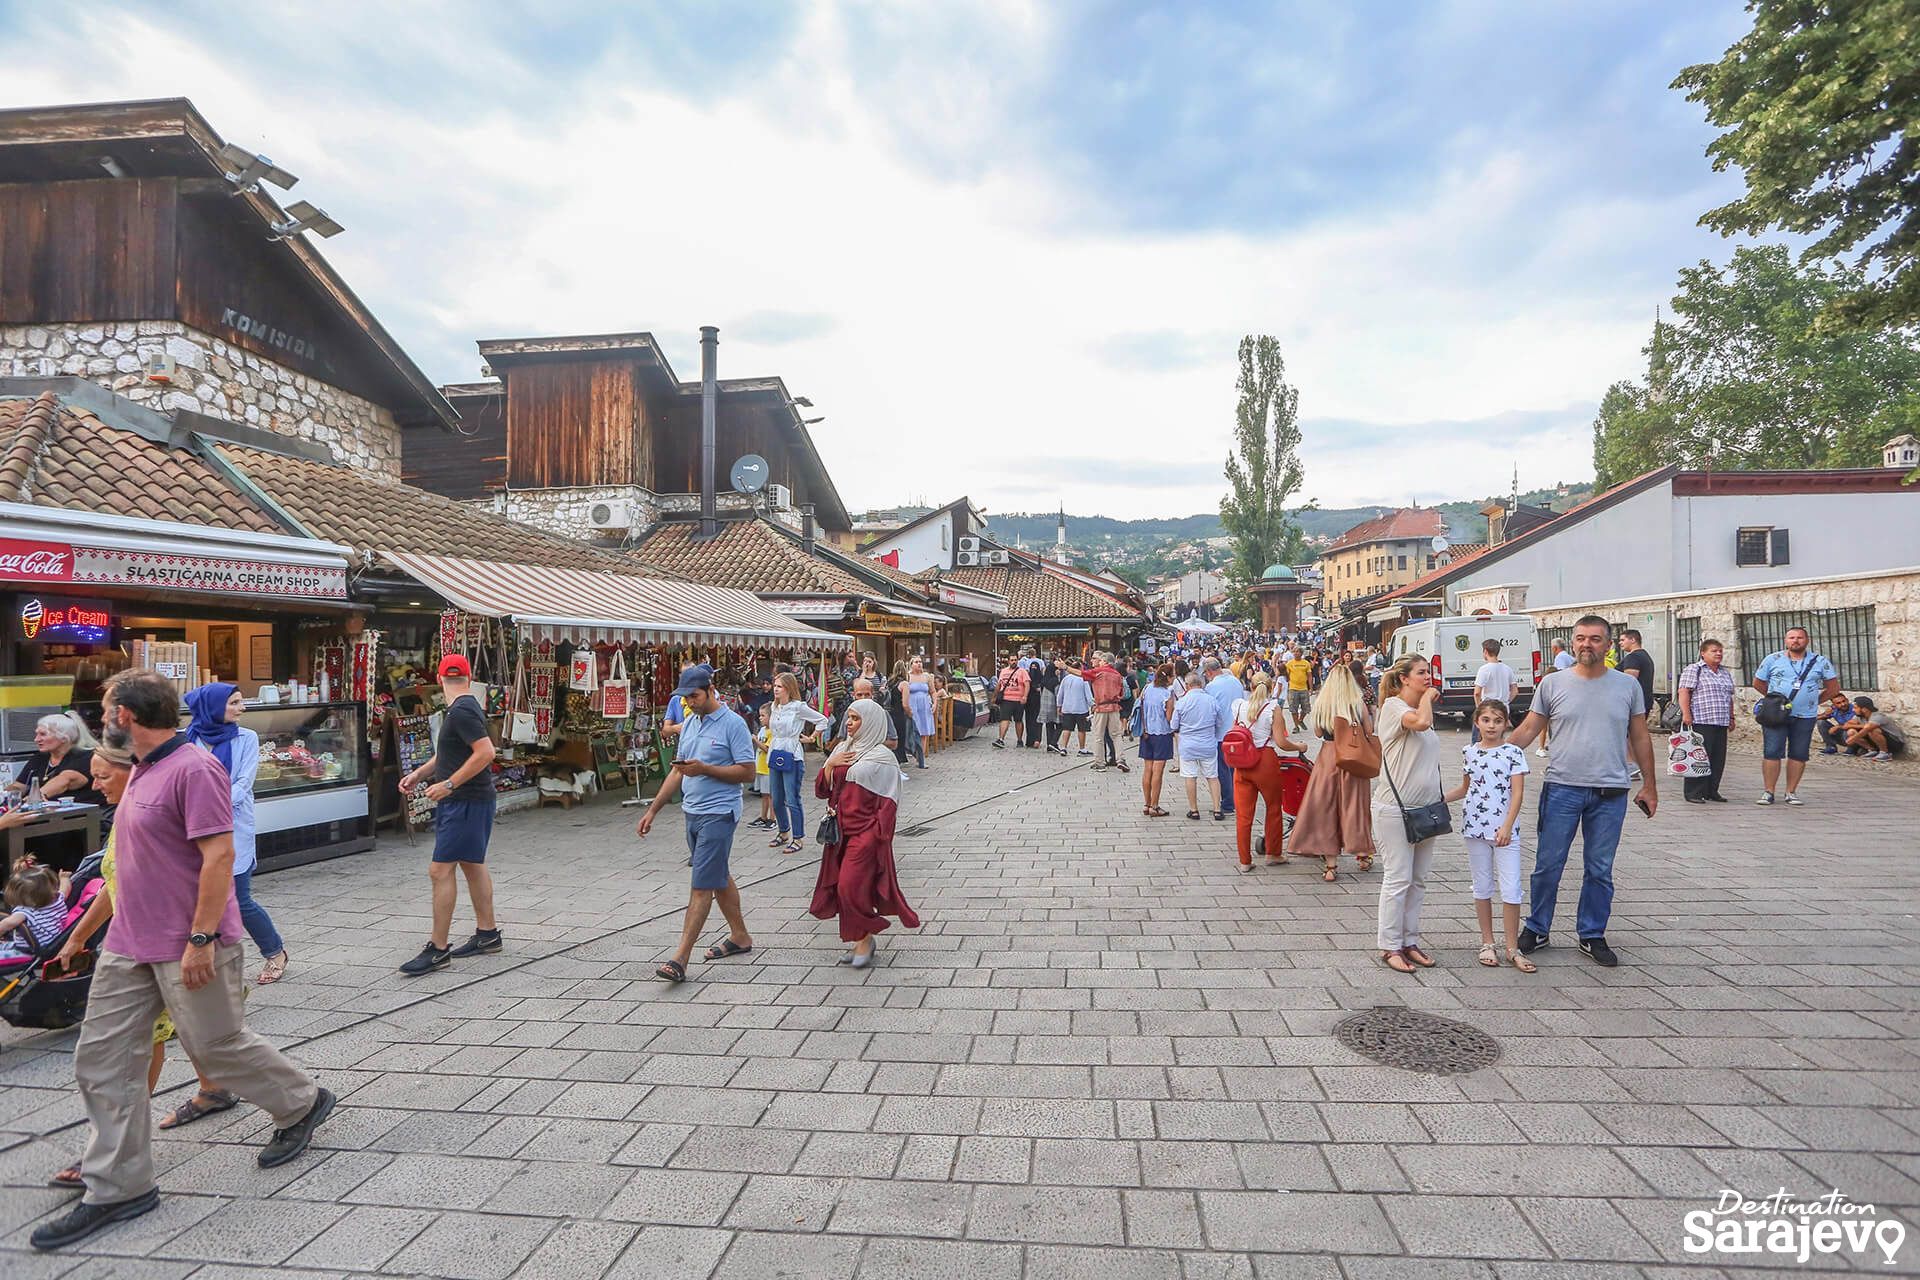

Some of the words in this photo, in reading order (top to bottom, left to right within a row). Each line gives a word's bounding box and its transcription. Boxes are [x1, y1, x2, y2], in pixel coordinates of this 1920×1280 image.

[0, 550, 69, 576] ca-Cola
[126, 566, 233, 582] SLASTIČARNA
[238, 573, 283, 586] CREAM
[287, 576, 320, 588] SHOP
[42, 607, 64, 627] Ice
[68, 605, 109, 627] Cream
